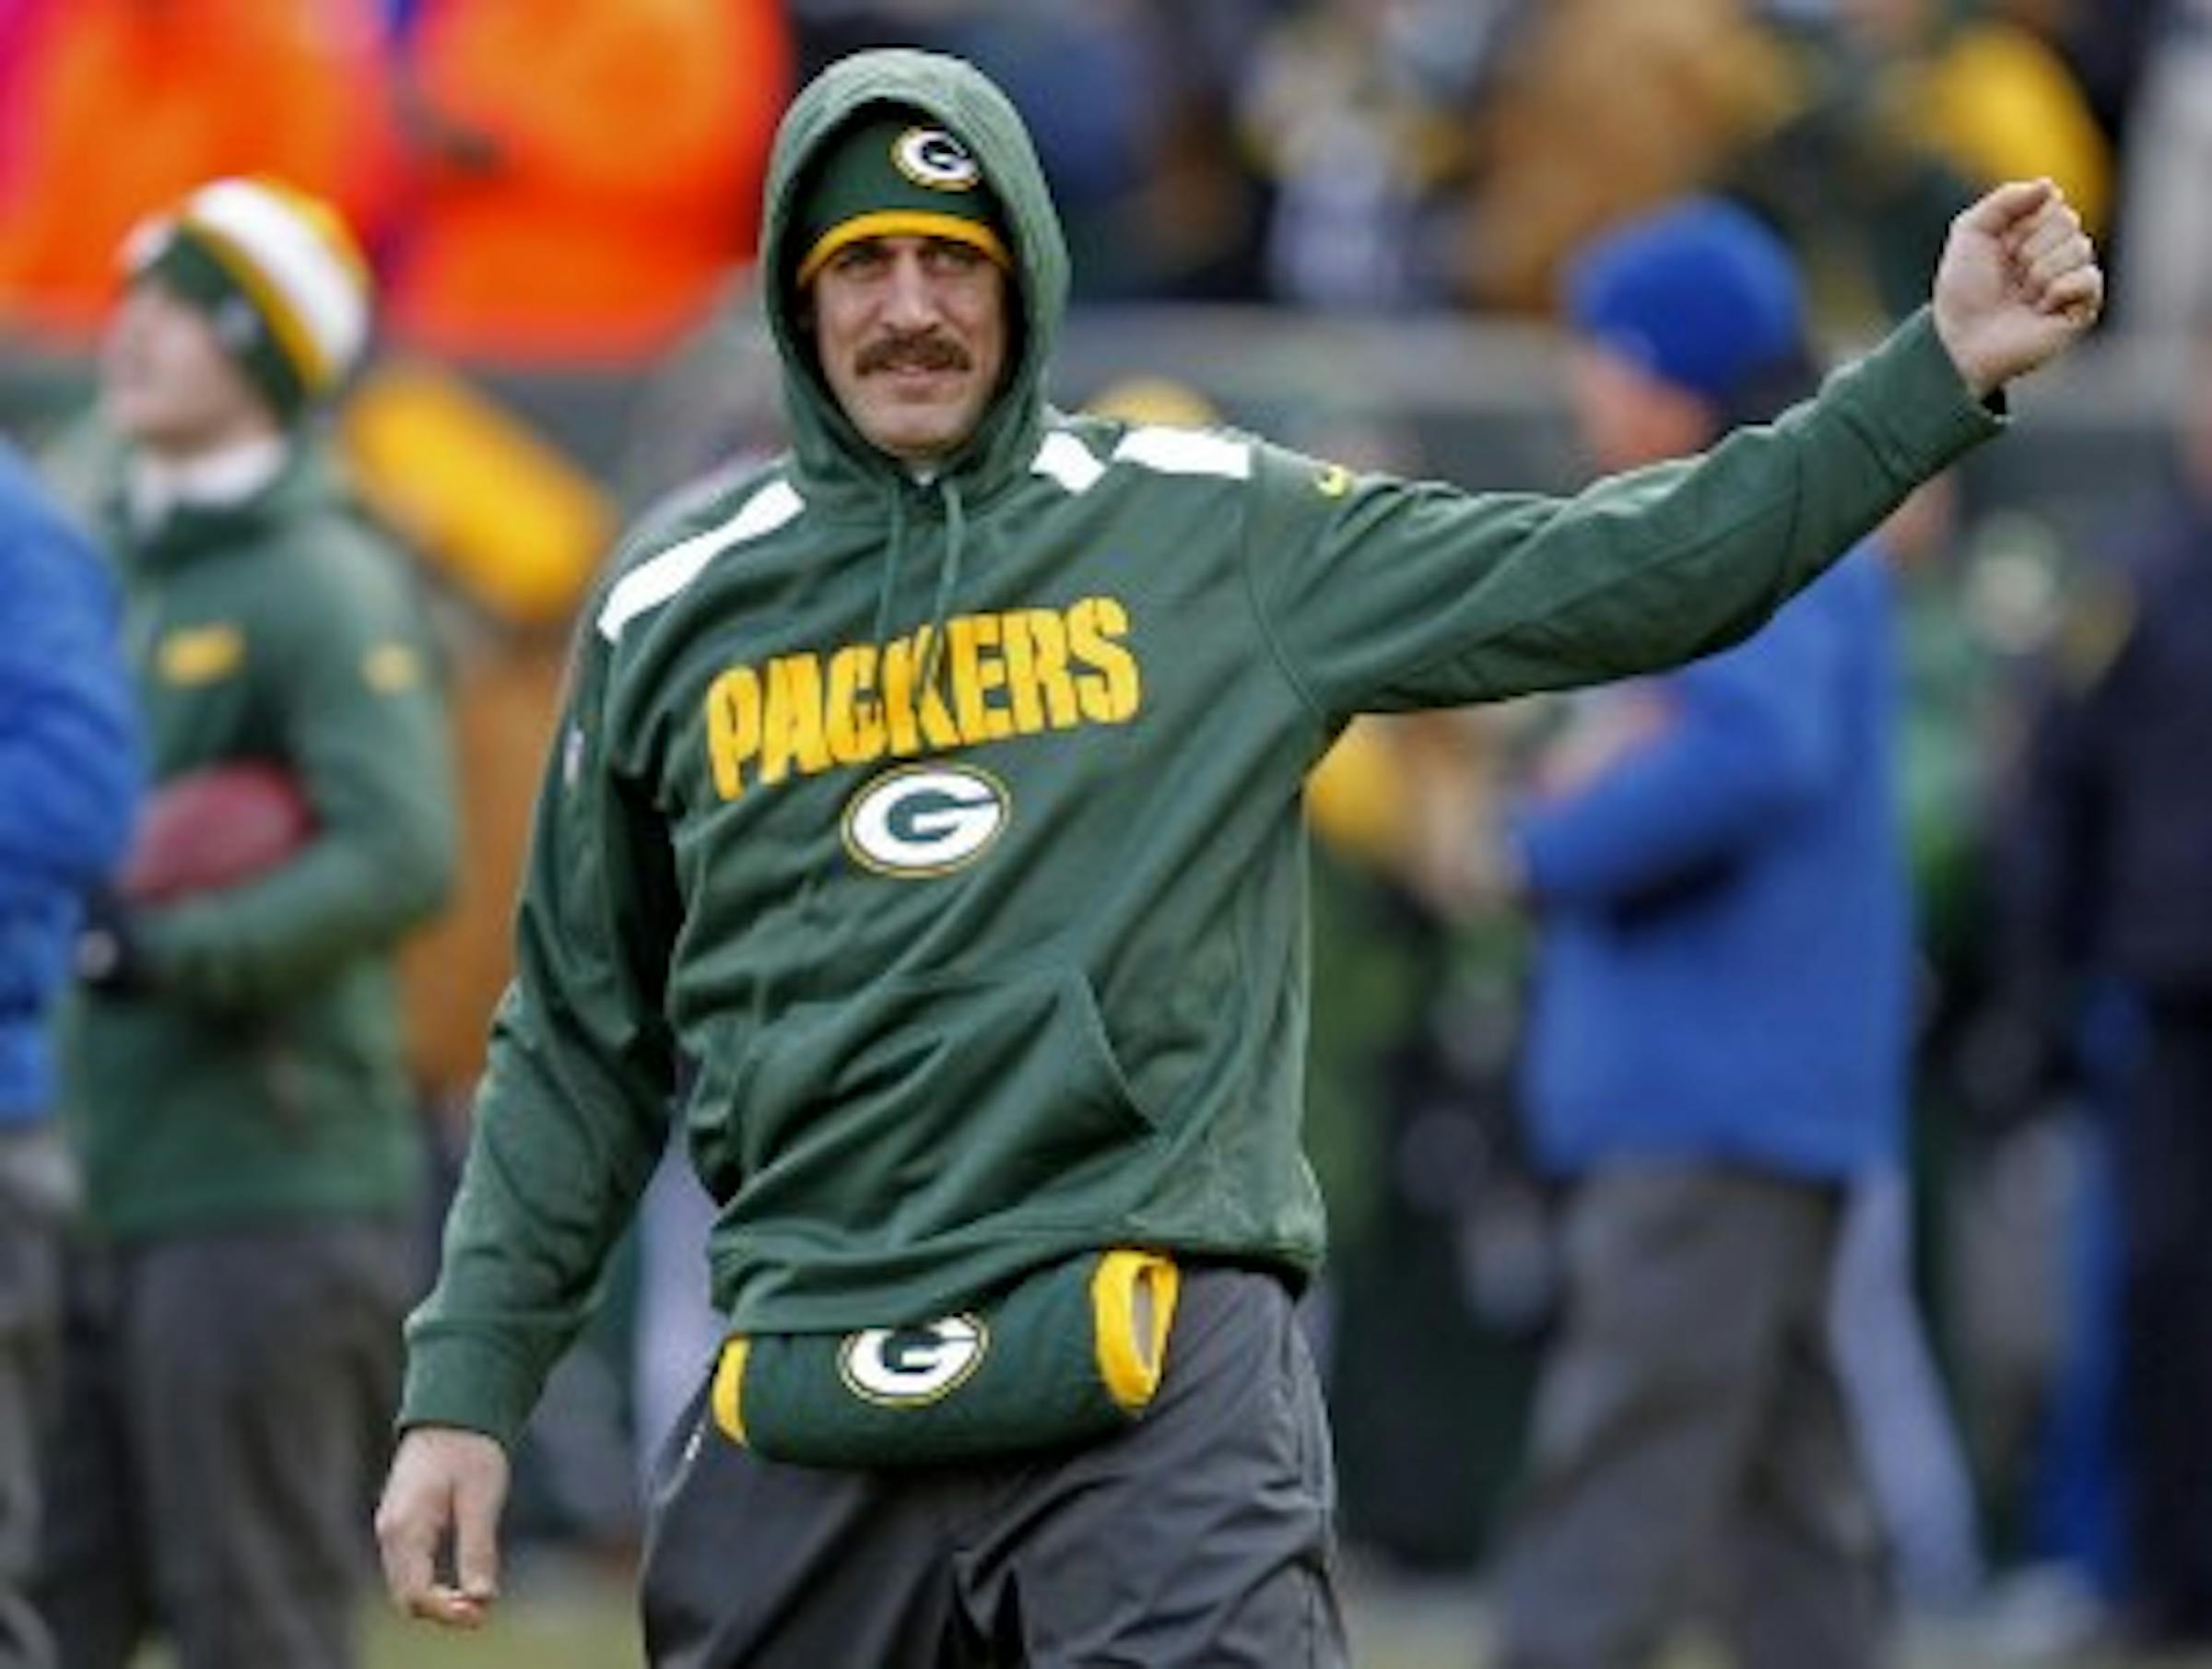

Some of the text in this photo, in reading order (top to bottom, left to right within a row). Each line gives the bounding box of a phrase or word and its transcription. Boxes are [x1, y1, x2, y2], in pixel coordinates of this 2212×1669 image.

[707, 596, 1139, 800] PACKERS
[845, 765, 1006, 874] G
[841, 1312, 986, 1403] G
